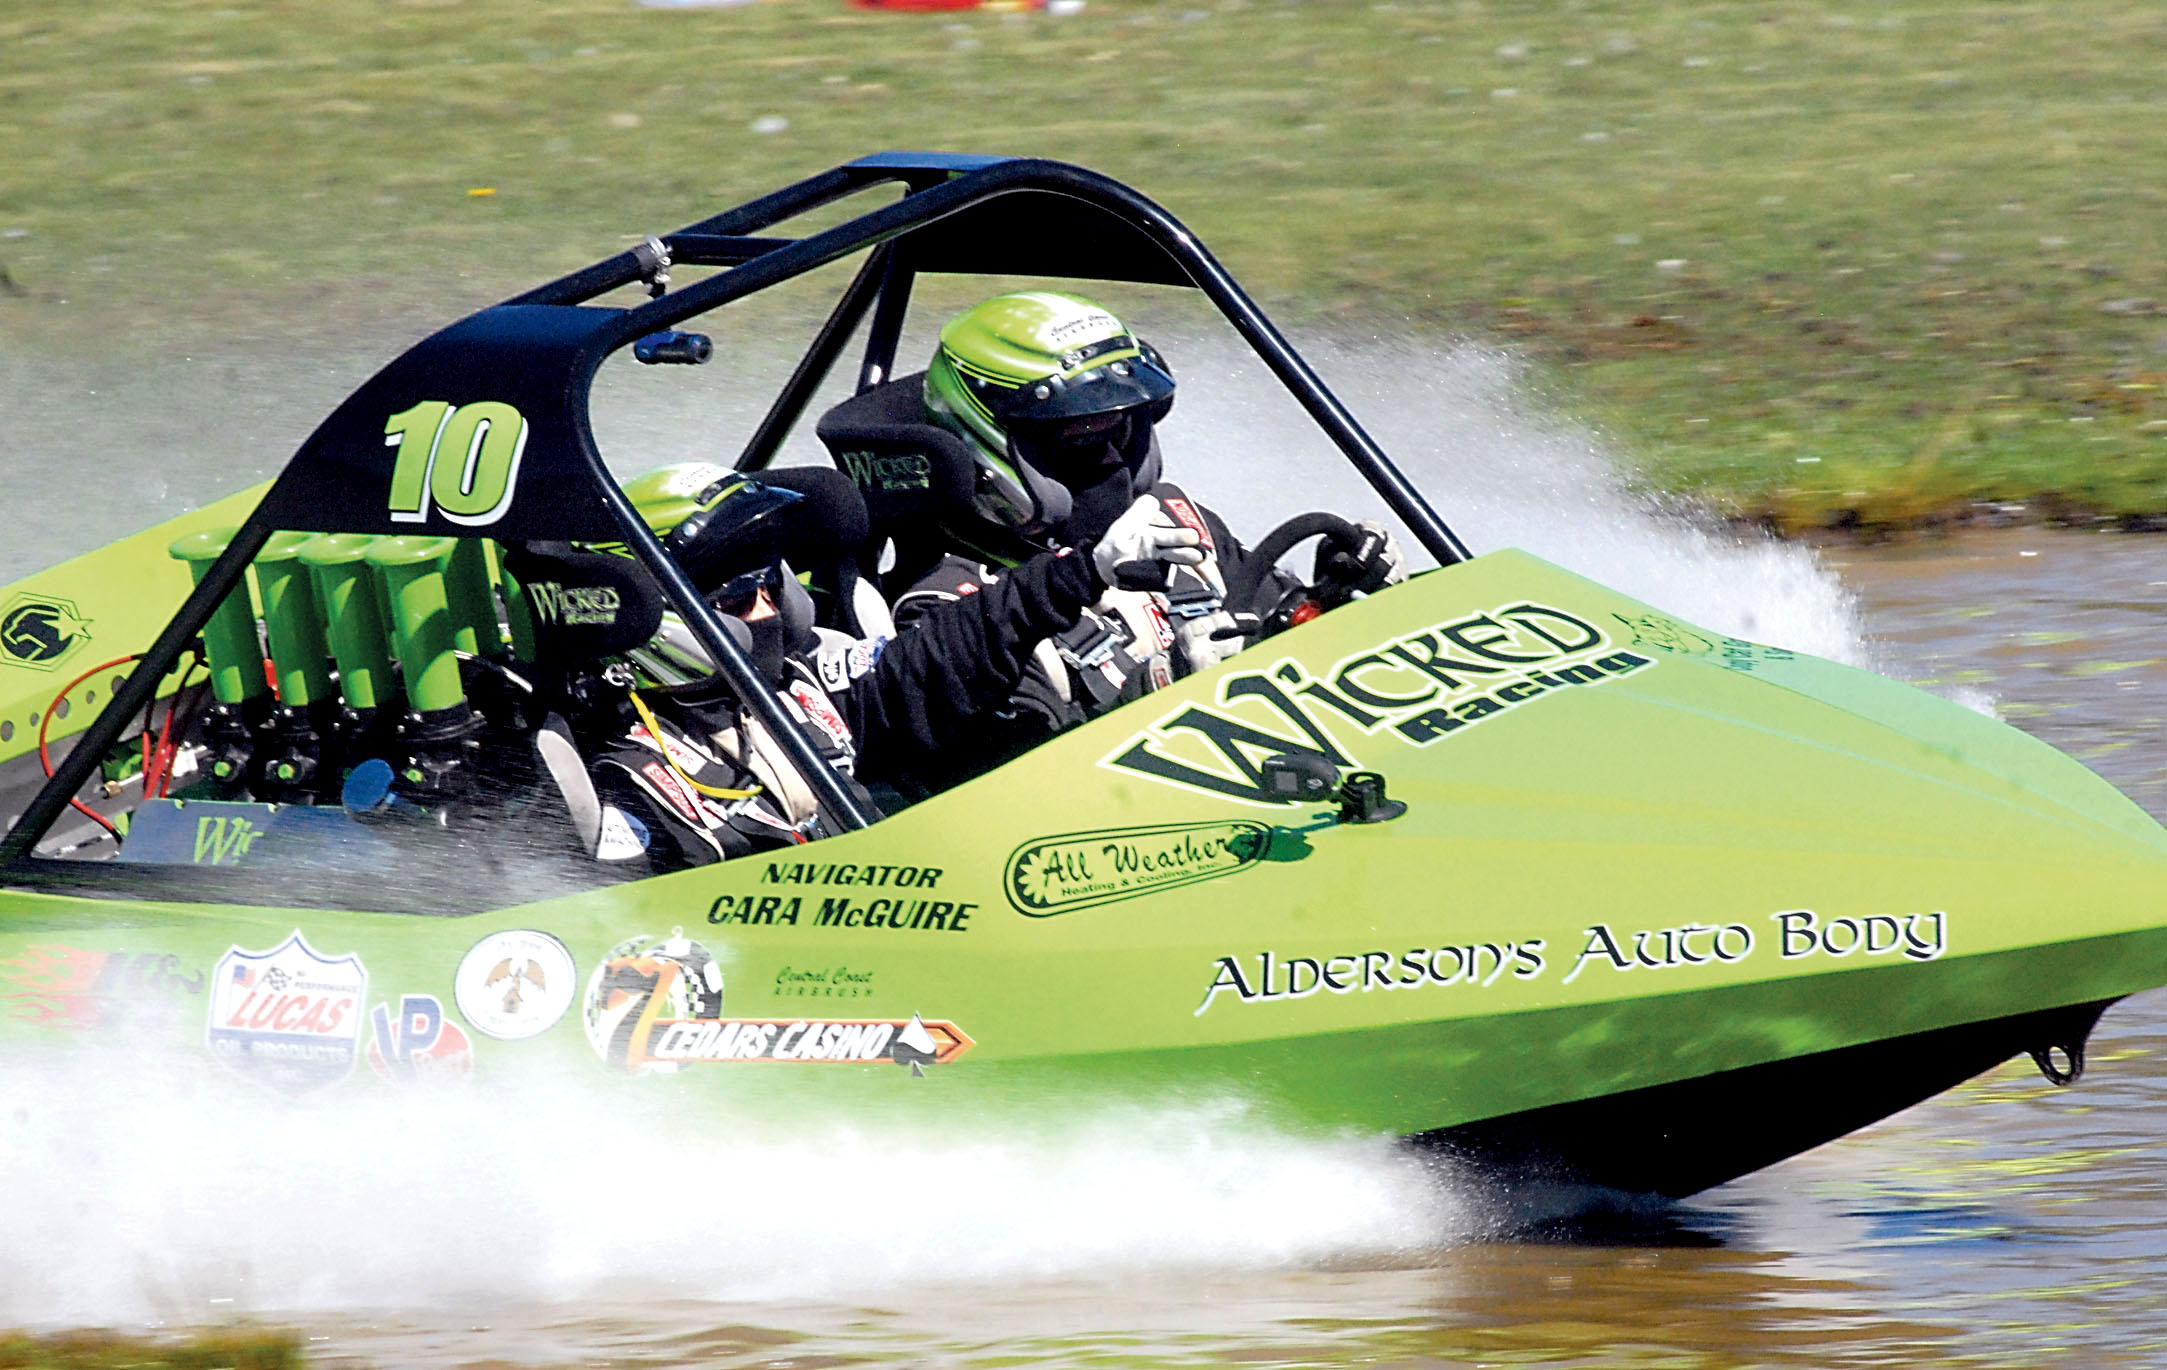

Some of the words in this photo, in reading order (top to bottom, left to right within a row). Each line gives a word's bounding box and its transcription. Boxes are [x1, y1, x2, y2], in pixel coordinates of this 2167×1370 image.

[384, 400, 529, 526] 10
[1388, 650, 1657, 747] Racing
[761, 863, 943, 888] NAVIGATOR
[1043, 850, 1094, 887] All
[1103, 835, 1228, 872] Weather
[1061, 881, 1115, 897] Heating
[1121, 878, 1129, 887] &
[708, 896, 802, 926] CARA
[813, 897, 979, 931] McGUIRE
[1562, 922, 1755, 985] AUTO
[1770, 909, 1946, 962] BODY
[226, 991, 353, 1033] LUCAS
[254, 1041, 349, 1064] PRODUCTS
[370, 994, 444, 1080] VP
[654, 1022, 776, 1059] CEDARS
[772, 1020, 893, 1060] CASINO
